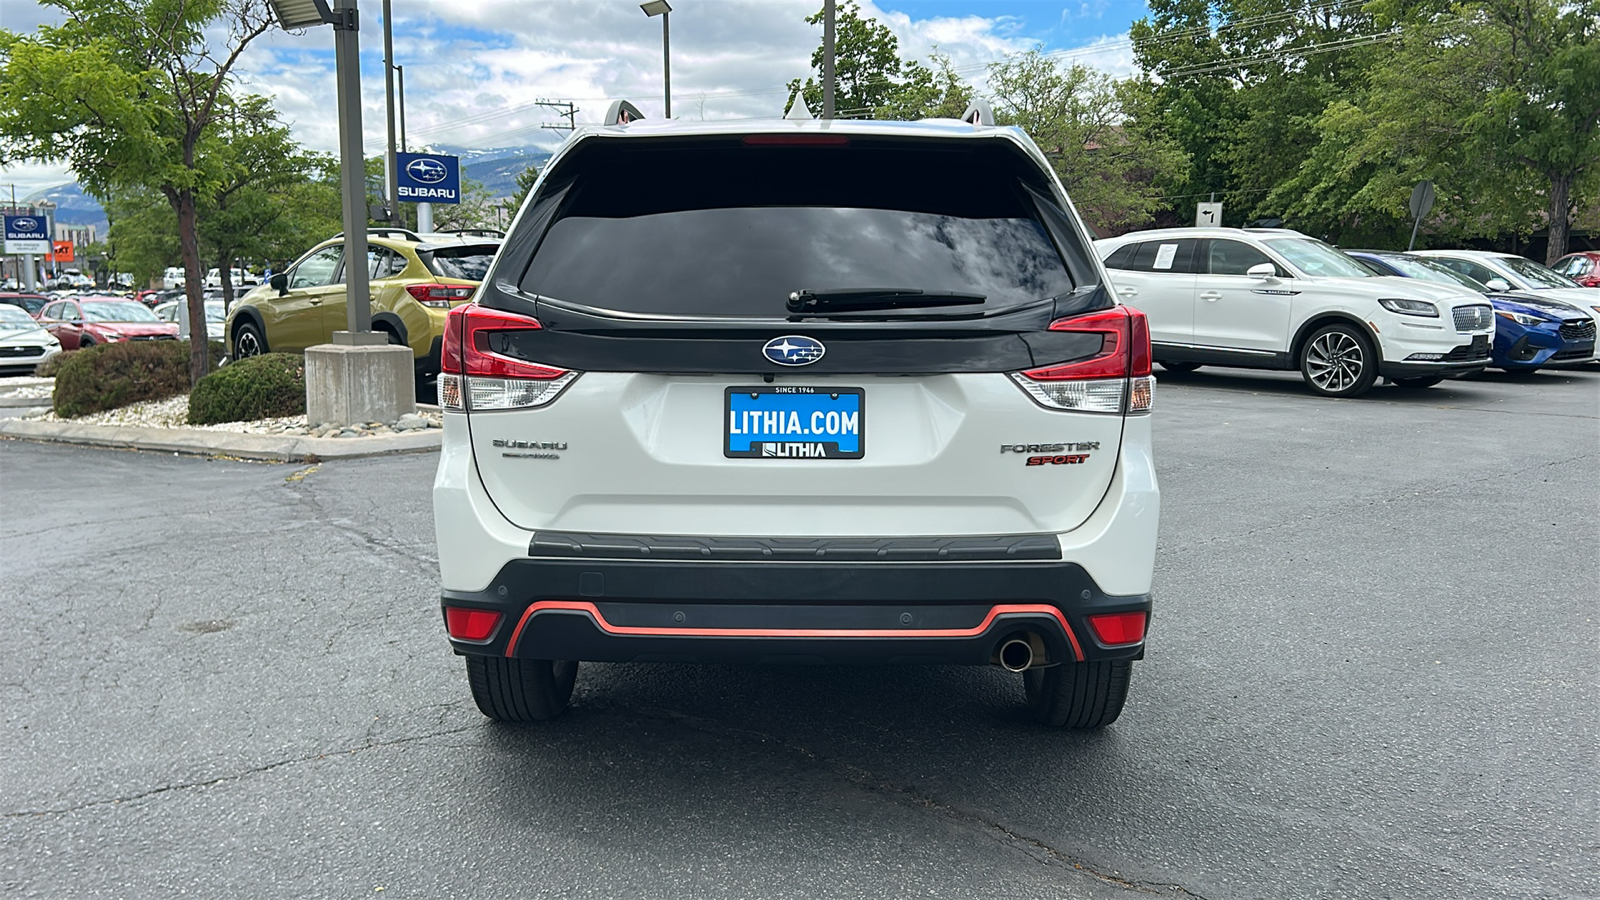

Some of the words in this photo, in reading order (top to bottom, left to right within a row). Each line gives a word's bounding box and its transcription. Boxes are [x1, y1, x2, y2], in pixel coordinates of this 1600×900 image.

[398, 186, 455, 198] SUBARU
[730, 410, 859, 435] LITHIA.COM
[492, 439, 567, 450] SUBARU
[776, 442, 827, 457] LITHIA
[1000, 441, 1100, 454] FORESTER
[1026, 454, 1090, 466] SPORT
